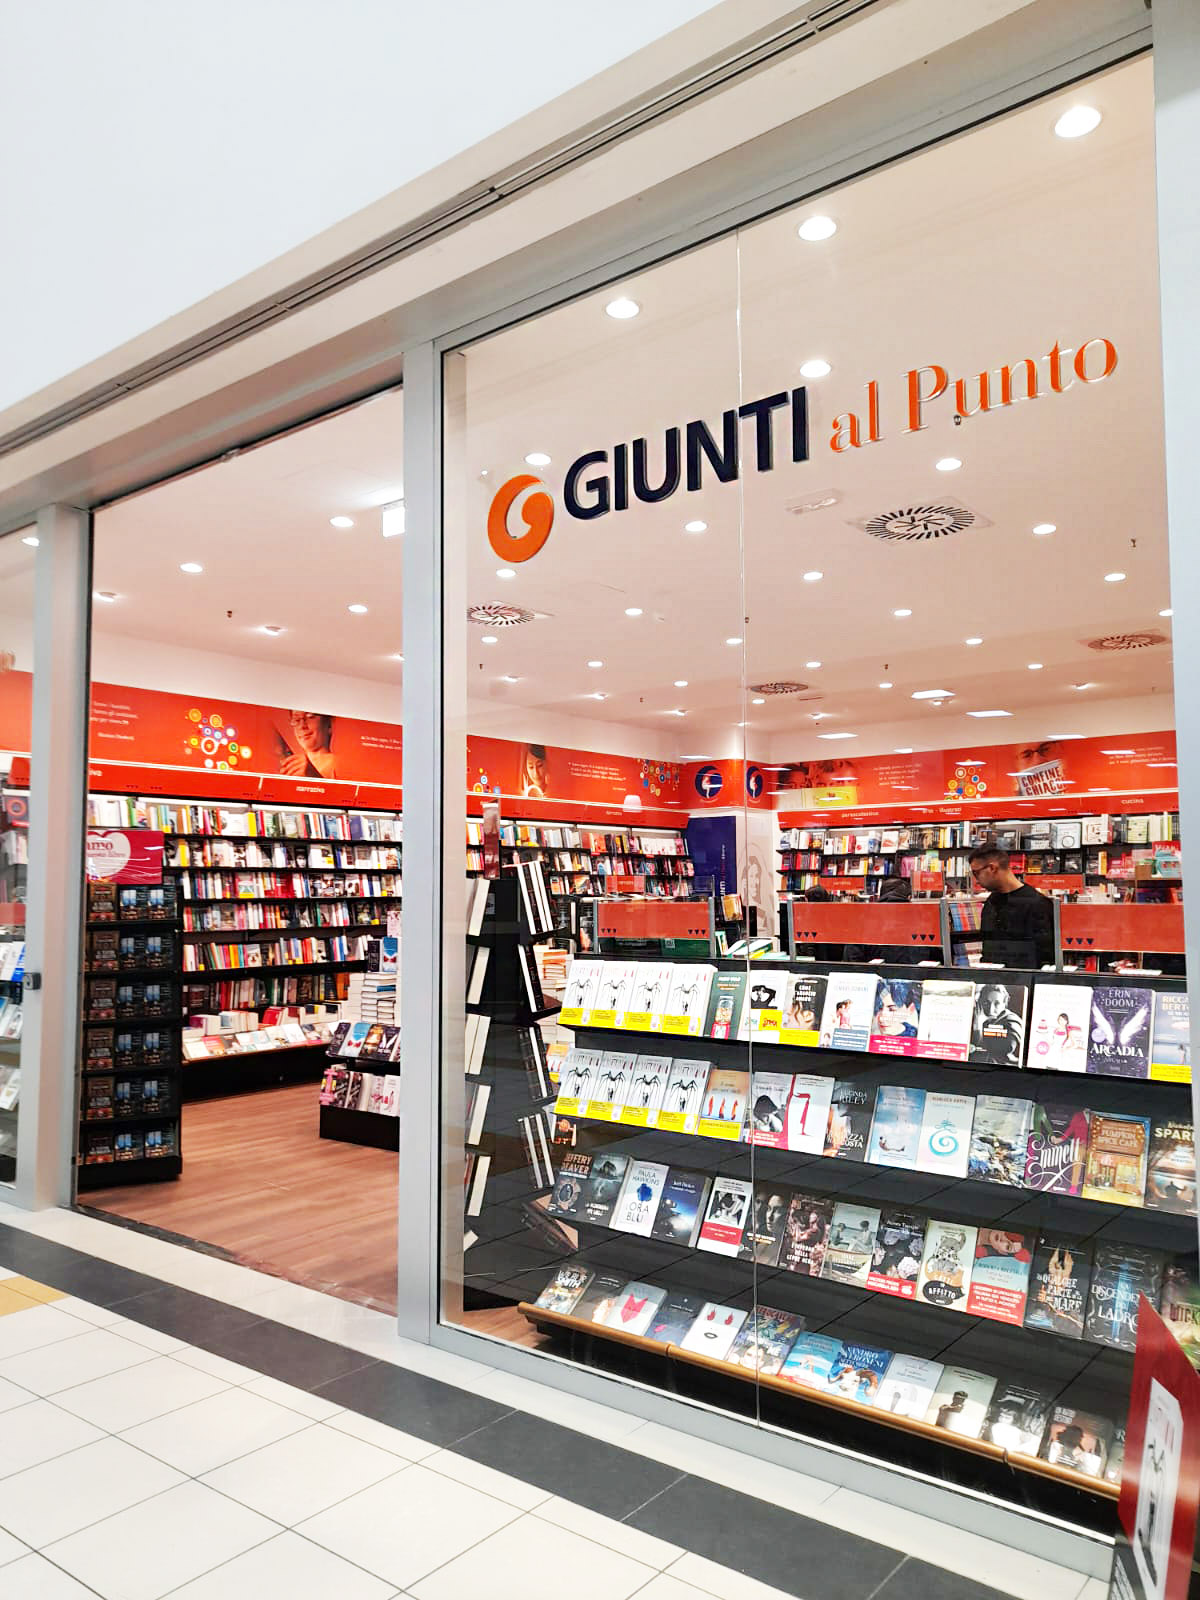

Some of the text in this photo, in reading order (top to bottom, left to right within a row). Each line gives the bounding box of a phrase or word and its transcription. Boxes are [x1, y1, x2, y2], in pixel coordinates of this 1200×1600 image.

[563, 337, 1119, 521] GIUNTI al Punto
[1108, 989, 1131, 999] ERIN
[1104, 998, 1135, 1008] DOOM
[1162, 1003, 1189, 1011] BERT
[1090, 1043, 1145, 1058] ARCADIA
[626, 1211, 645, 1223] BLU
[928, 1287, 956, 1300] AFFITTO
[1054, 1297, 1082, 1313] MARE
